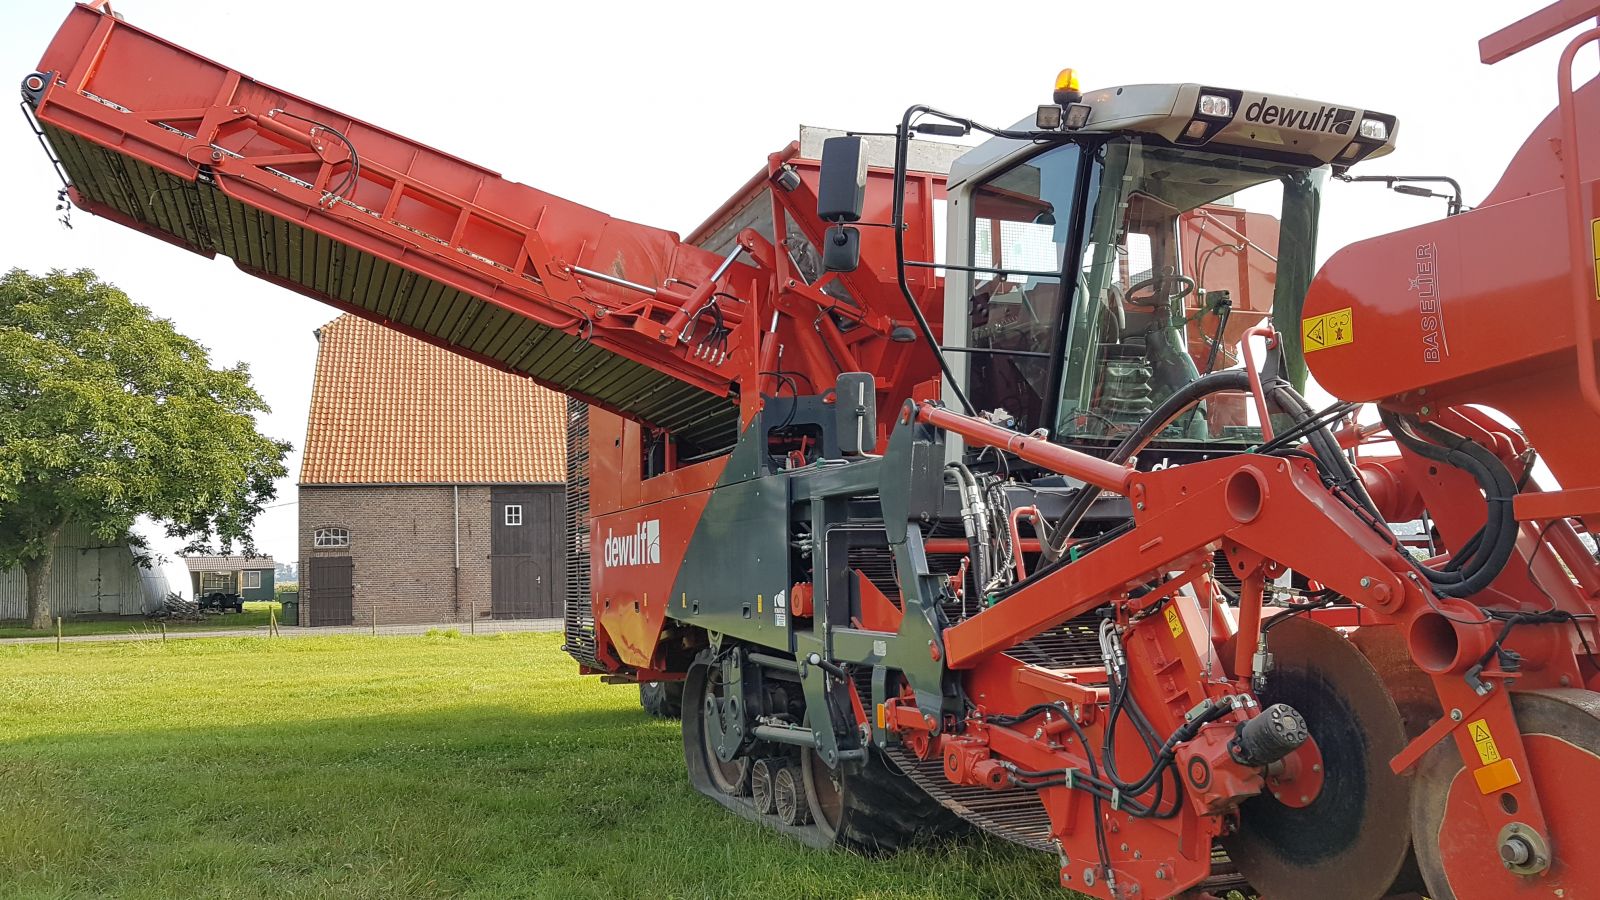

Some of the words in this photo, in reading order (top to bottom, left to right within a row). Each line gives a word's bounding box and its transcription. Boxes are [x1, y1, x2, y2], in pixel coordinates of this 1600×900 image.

[1245, 97, 1336, 132] dewulf
[1416, 243, 1440, 362] BASELIER
[605, 521, 646, 567] dewulf
